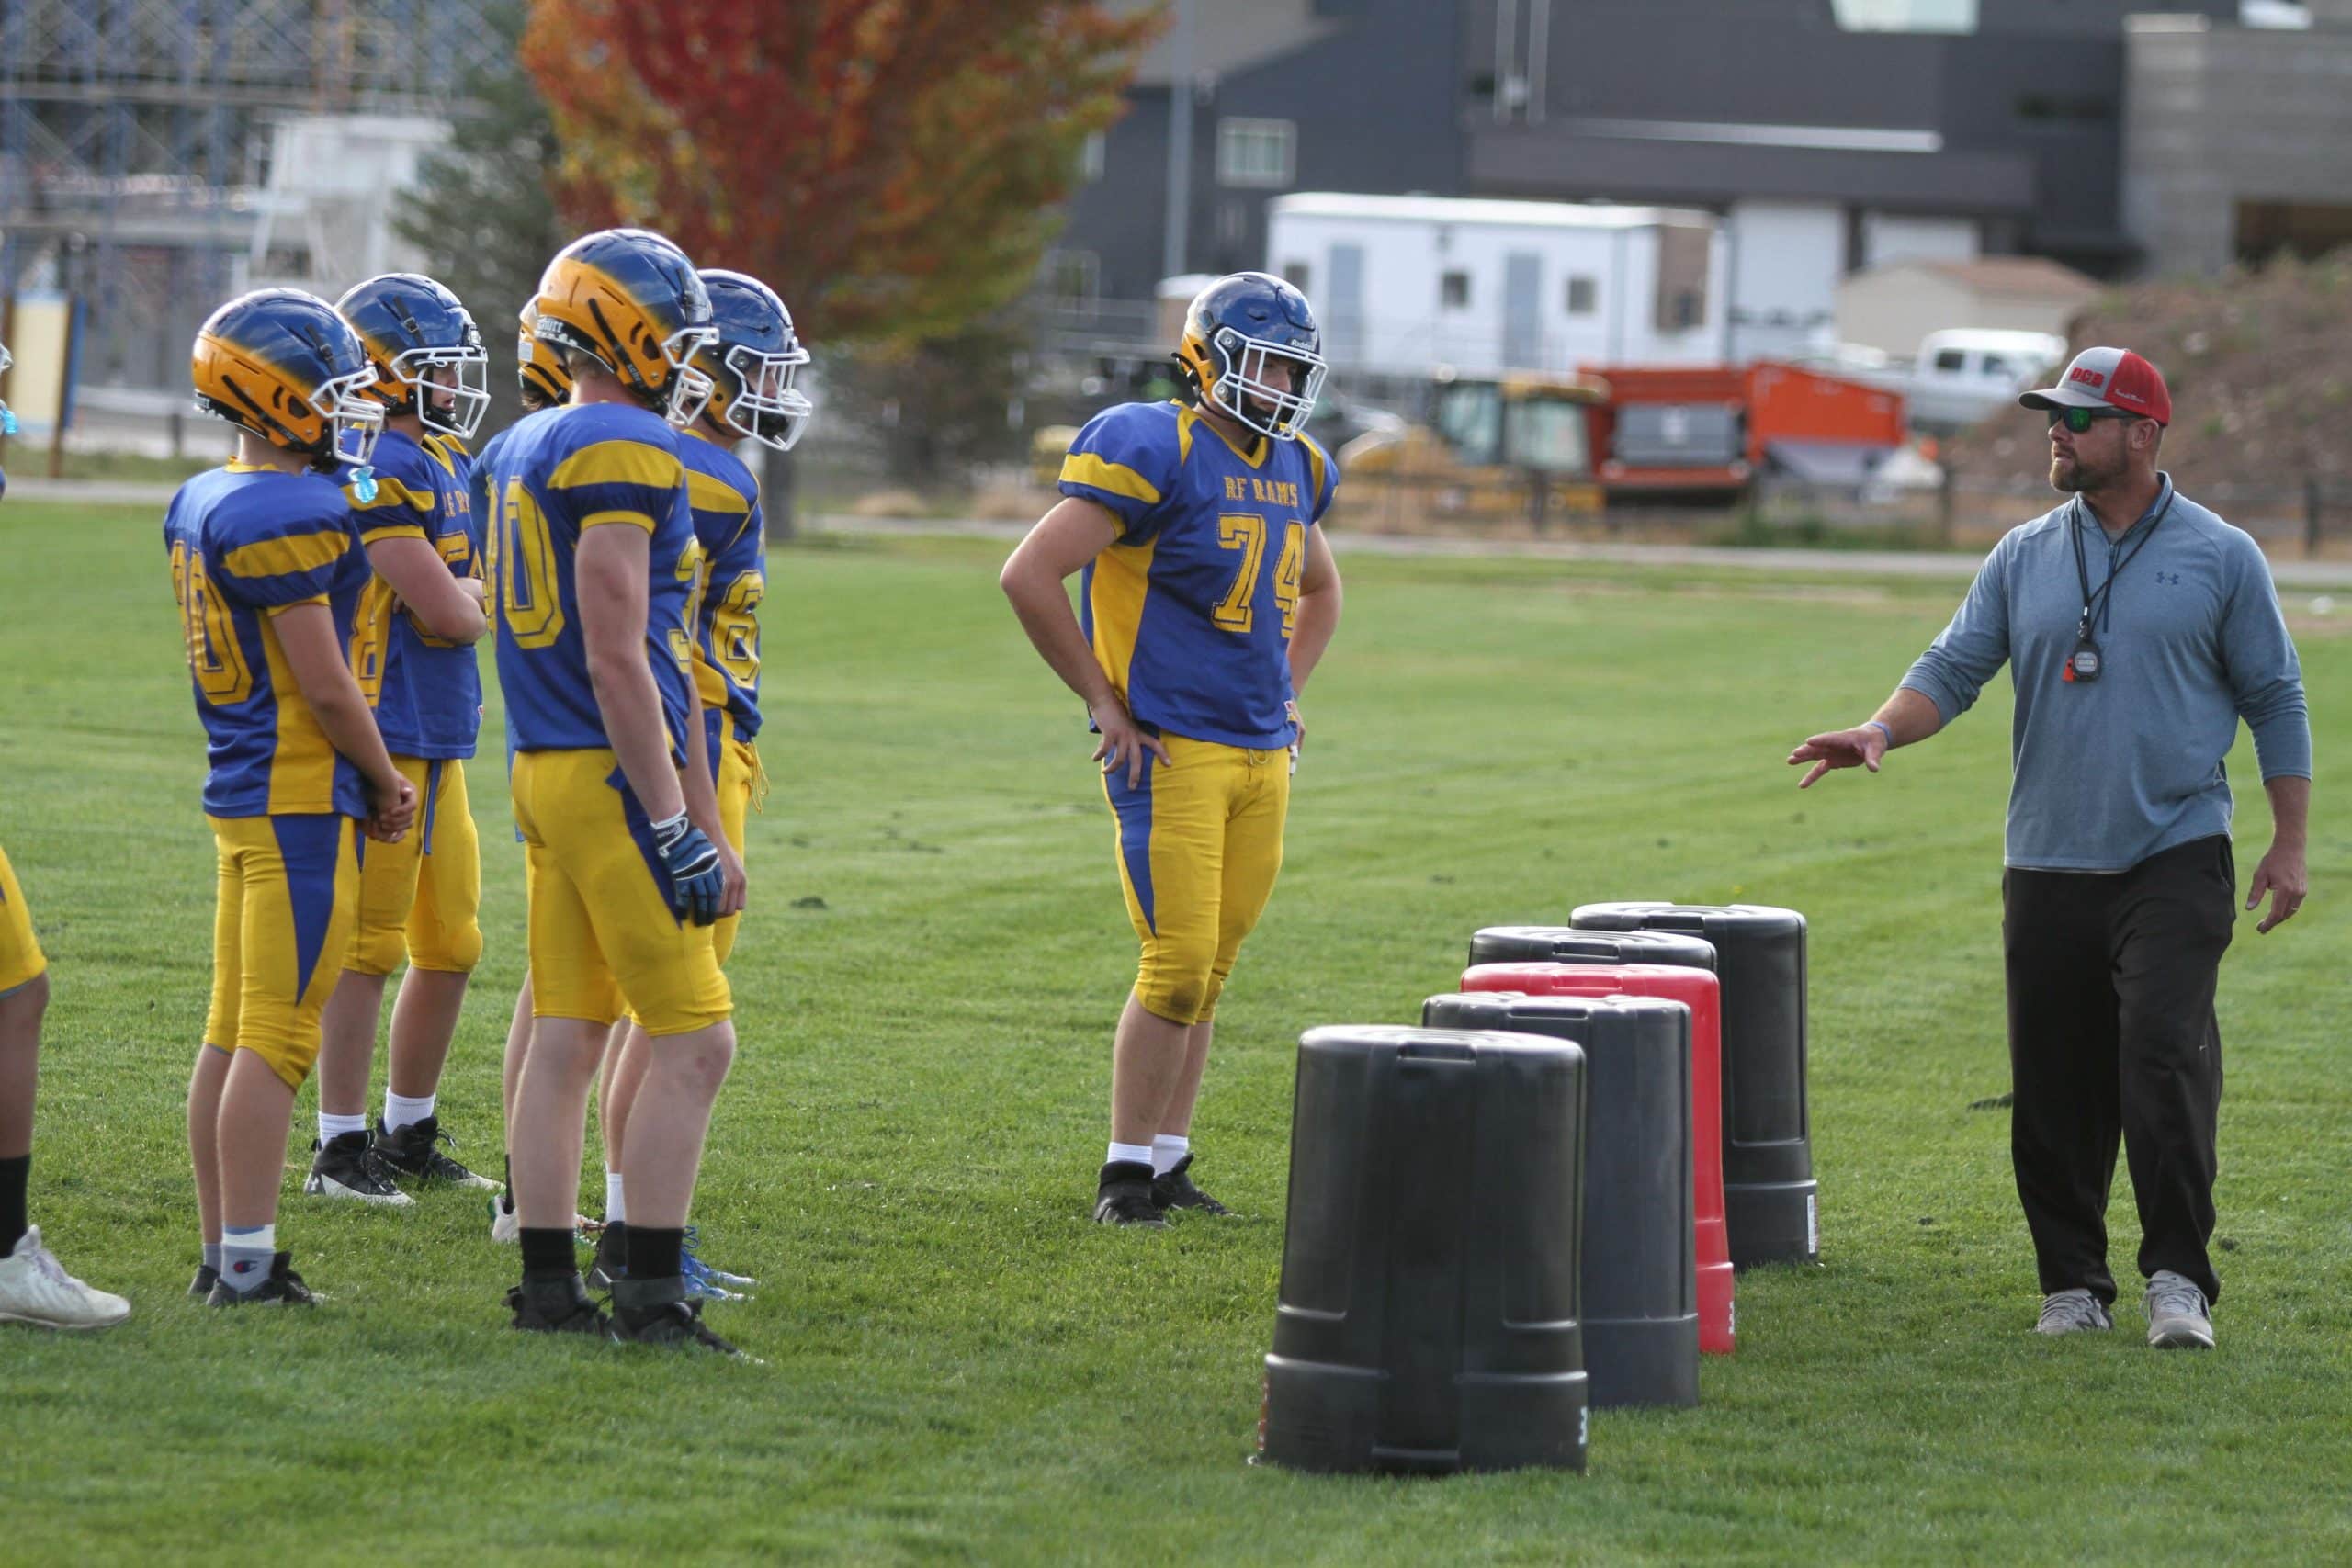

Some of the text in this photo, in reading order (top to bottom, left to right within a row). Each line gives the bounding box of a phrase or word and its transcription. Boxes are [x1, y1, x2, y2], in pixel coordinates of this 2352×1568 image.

[1224, 477, 1297, 508] RF RAMS
[1212, 513, 1306, 637] 74
